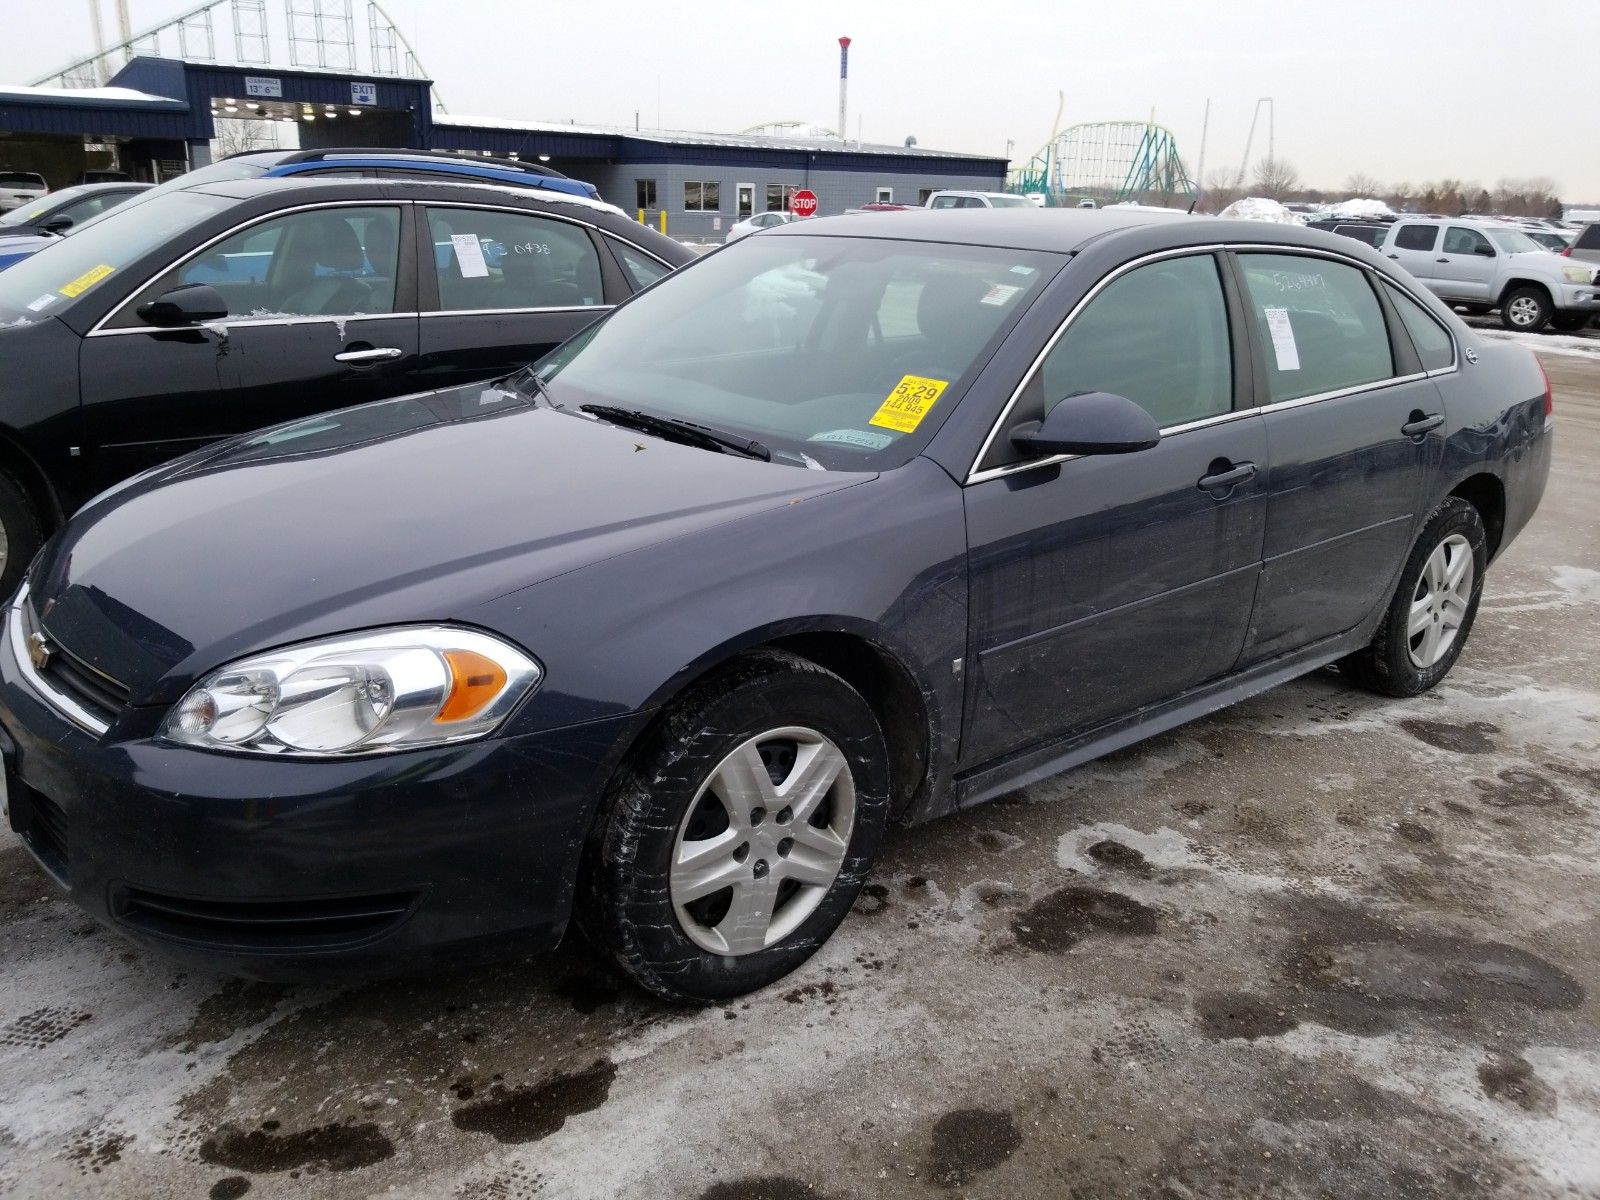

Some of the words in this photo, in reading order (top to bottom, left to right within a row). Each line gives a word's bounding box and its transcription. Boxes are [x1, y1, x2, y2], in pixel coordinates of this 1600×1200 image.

[249, 85, 258, 93] 13
[352, 84, 375, 95] EXIT
[794, 198, 817, 209] STOP
[896, 394, 922, 405] 2009
